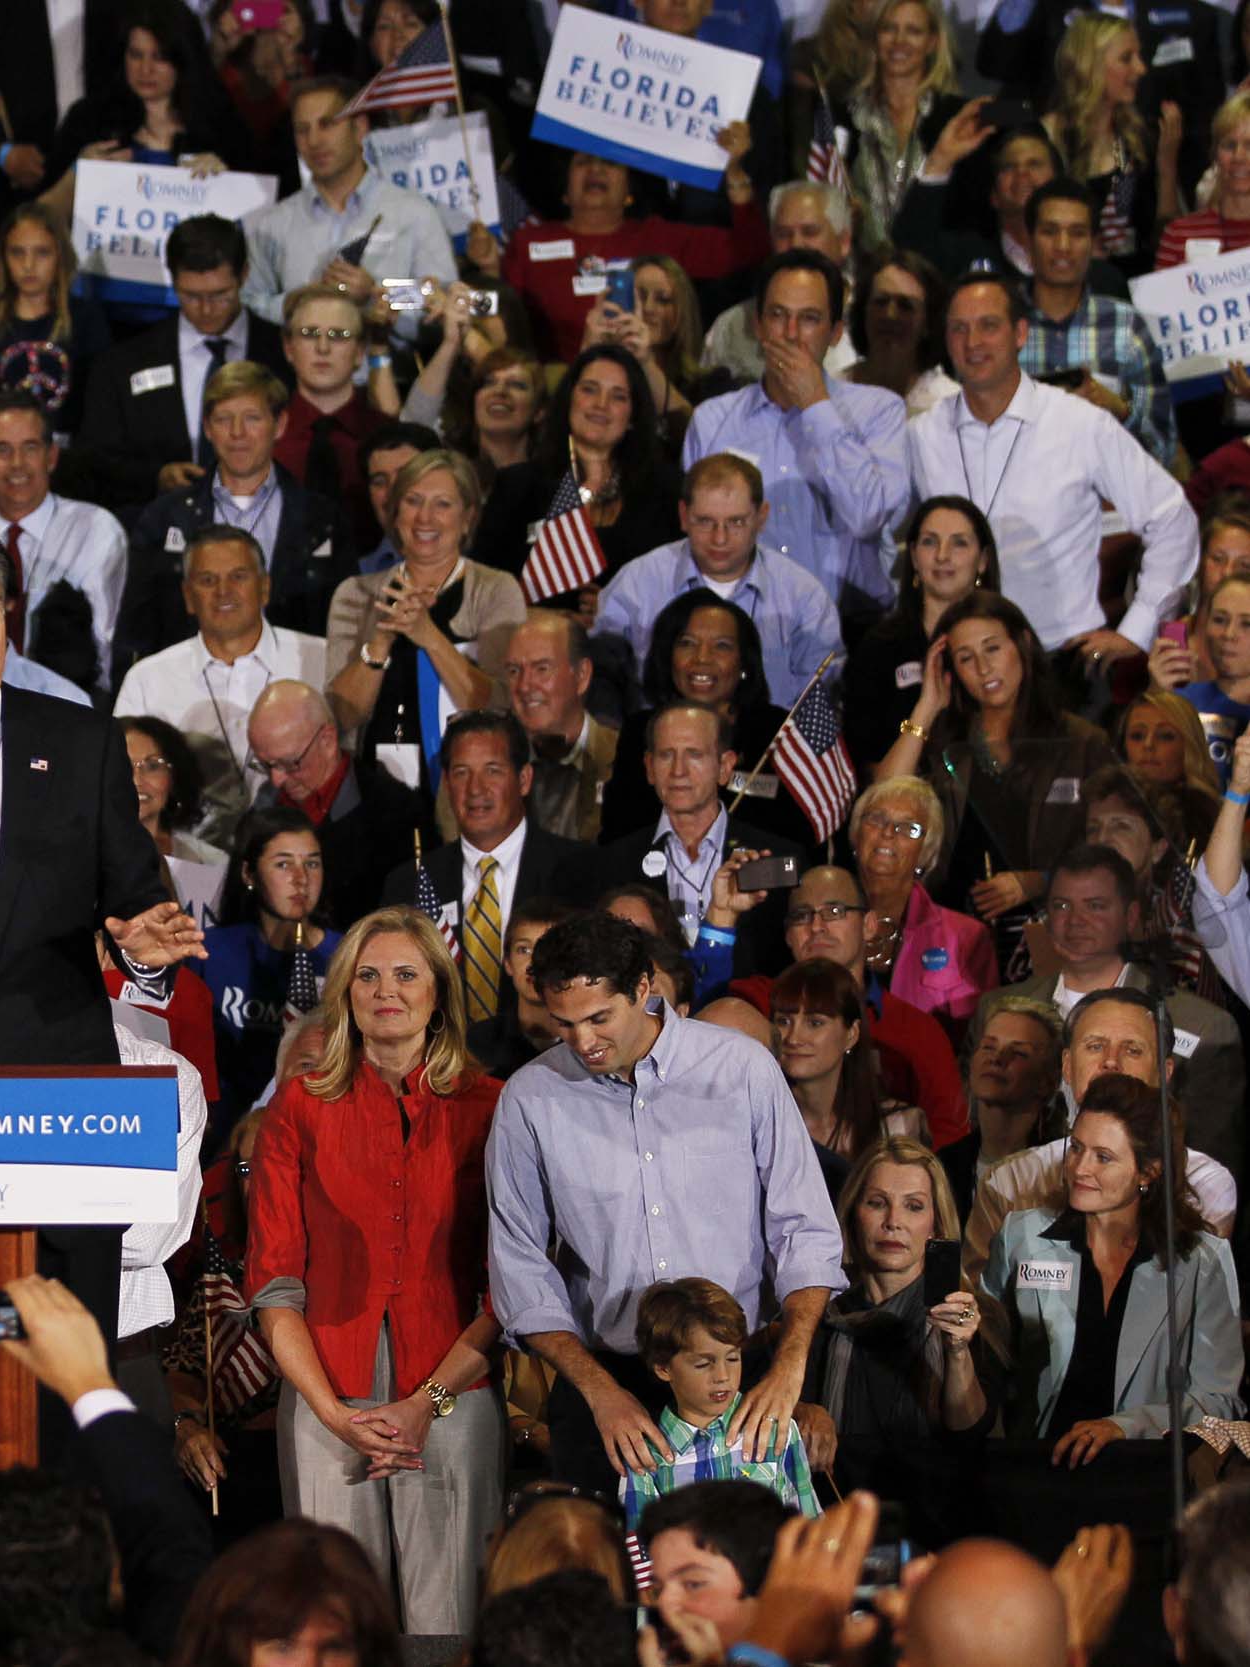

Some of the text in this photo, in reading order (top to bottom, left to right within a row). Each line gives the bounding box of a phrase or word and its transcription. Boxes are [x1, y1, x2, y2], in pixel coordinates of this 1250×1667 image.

[616, 32, 690, 71] ROMNEY
[556, 79, 722, 144] BELIEVES
[569, 56, 719, 117] FLORIDA
[1020, 1263, 1068, 1281] ROMNEY
